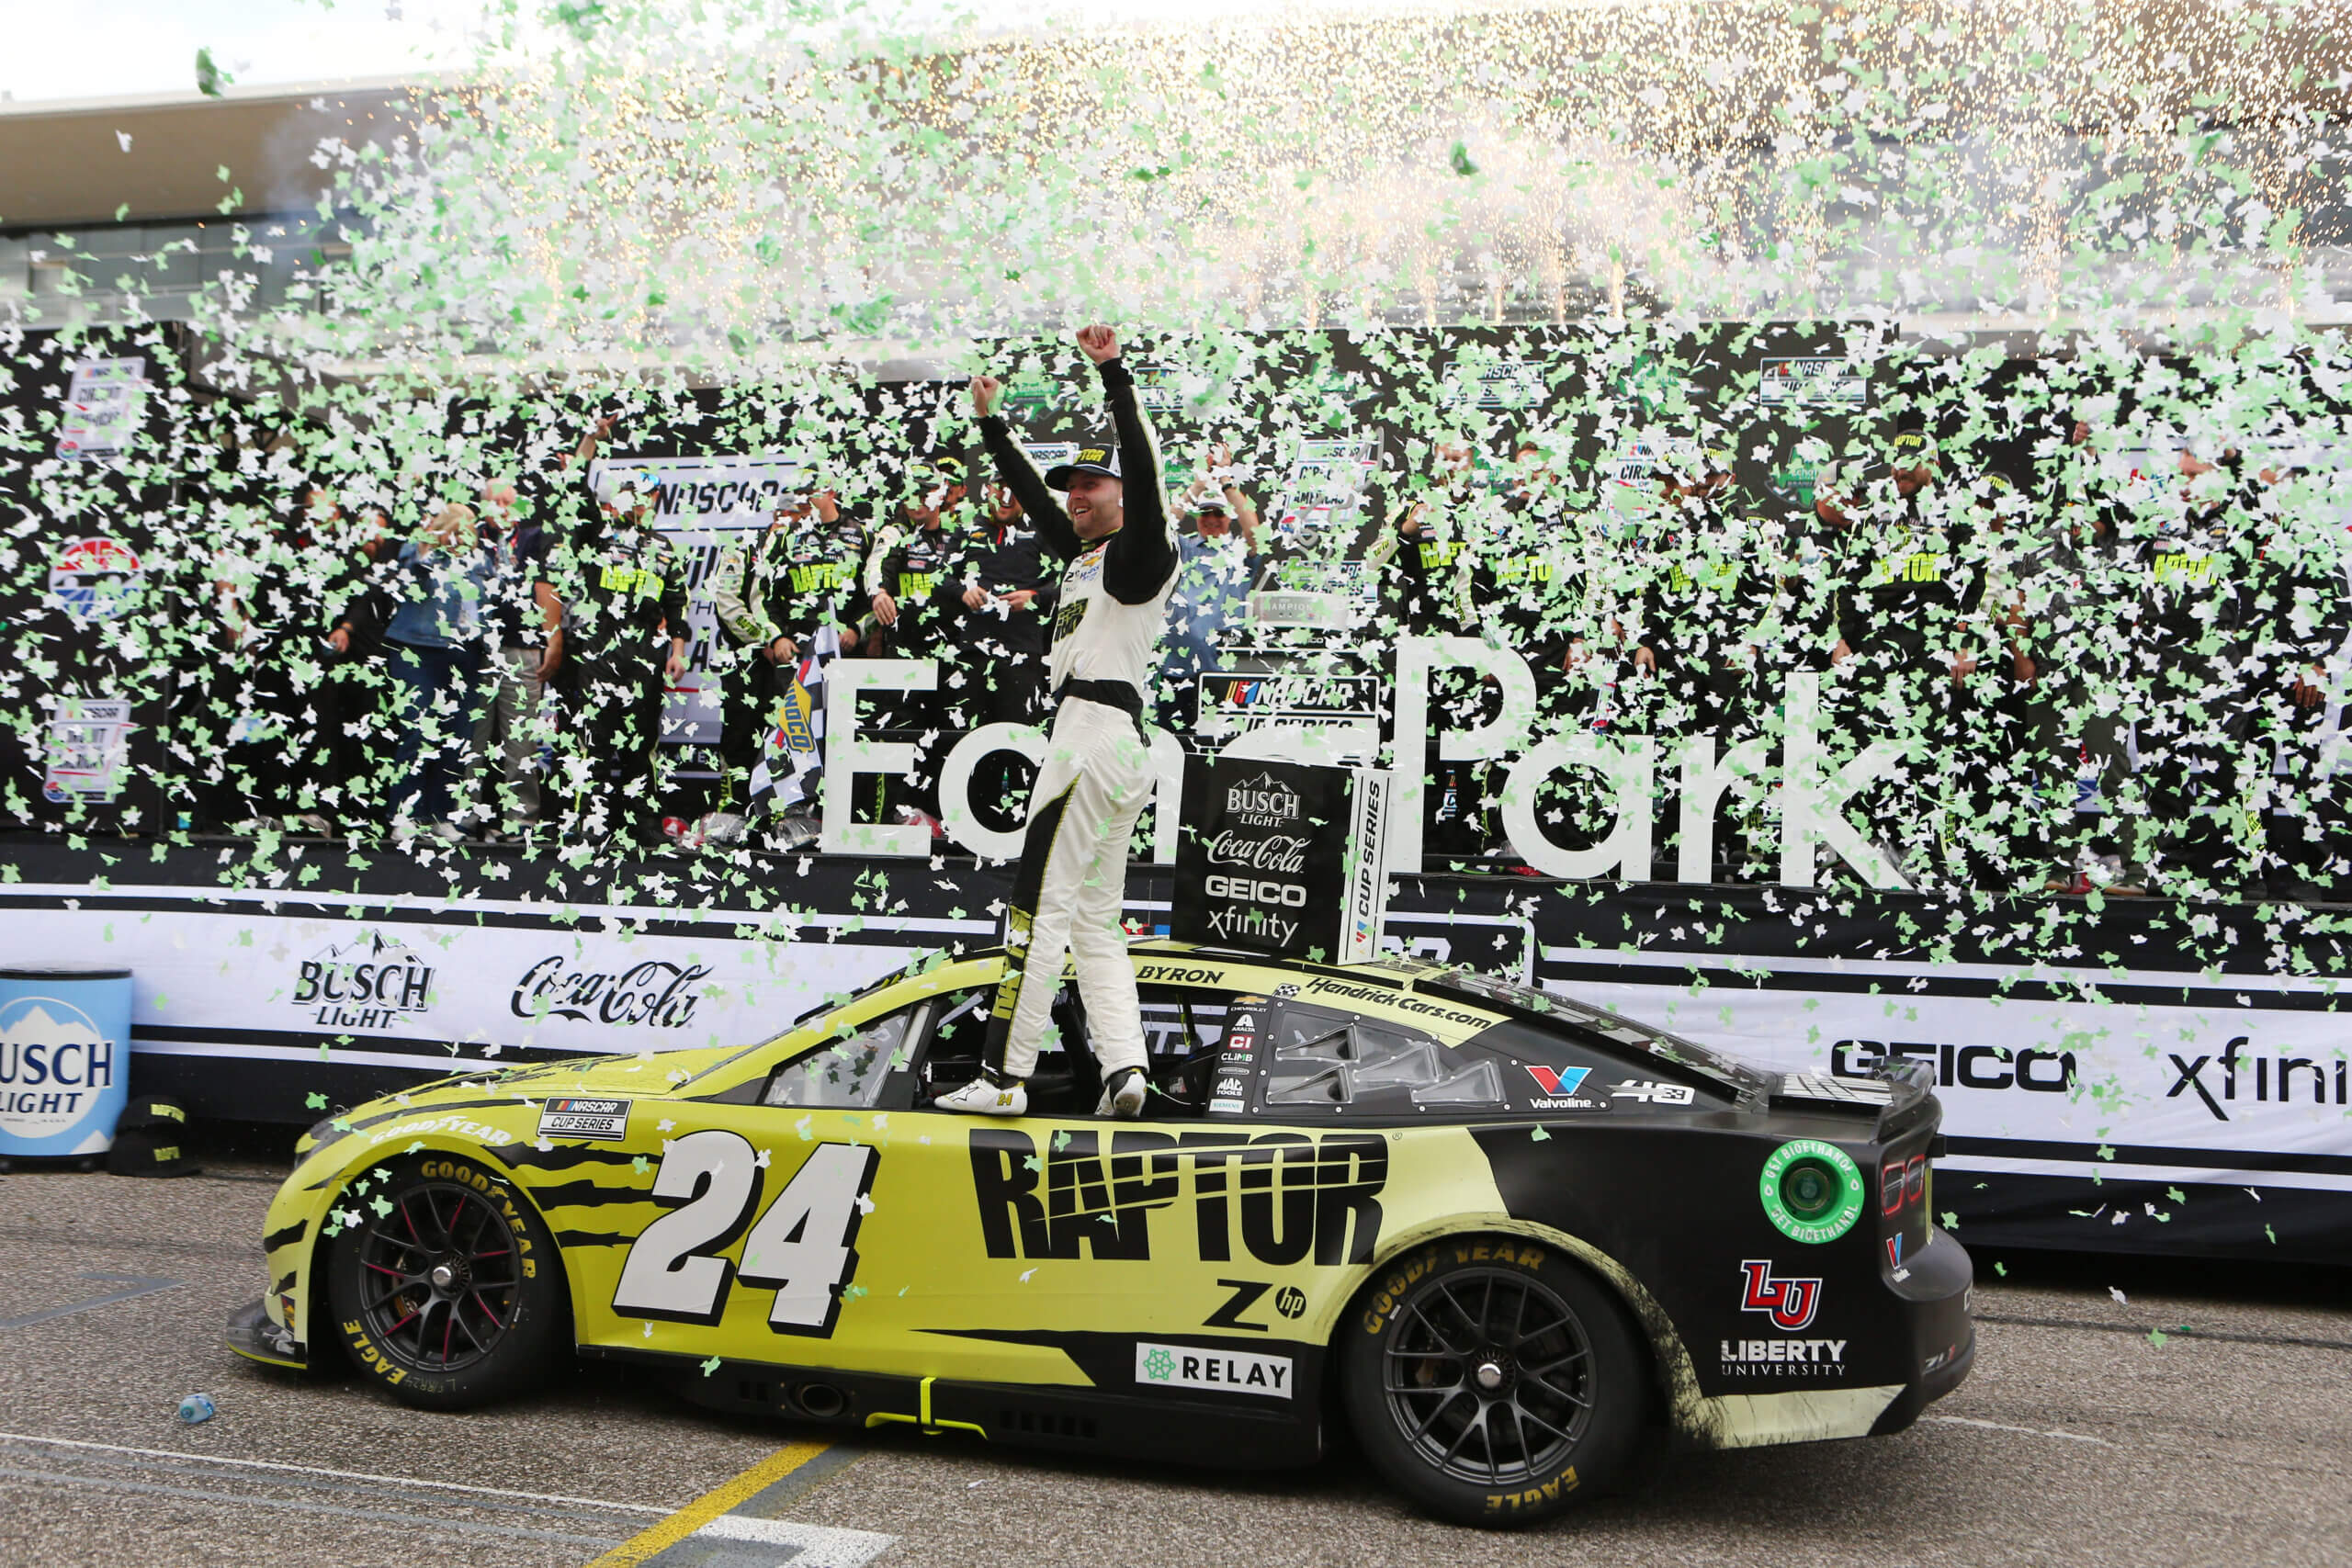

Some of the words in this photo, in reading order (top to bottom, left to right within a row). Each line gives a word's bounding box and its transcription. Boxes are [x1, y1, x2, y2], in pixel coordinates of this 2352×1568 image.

[1392, 636, 1911, 891] Park
[1226, 787, 1301, 819] BUSCH
[1240, 815, 1284, 828] LIGHT
[1363, 780, 1380, 866] SERIES
[1206, 829, 1312, 874] Coca-Cola
[1205, 875, 1307, 908] GEICO
[1358, 872, 1373, 918] CUP
[1207, 906, 1299, 948] xfinity
[291, 961, 436, 1011] BUSCH
[1137, 965, 1226, 985] BYRON
[314, 1007, 395, 1029] LIGHT
[1831, 1039, 2076, 1093] GEICO
[571, 1100, 618, 1113] NASCAR
[1529, 1098, 1593, 1110] Valvoline
[551, 1116, 574, 1128] CUP
[574, 1118, 615, 1130] SERIES
[1765, 1155, 1783, 1179] GET
[969, 1129, 1389, 1266] RAPTOR
[611, 1129, 881, 1339] 24
[343, 1319, 408, 1385] EAGLE
[1721, 1339, 1848, 1361] LIBERTY
[1182, 1356, 1287, 1389] RELAY
[1722, 1364, 1847, 1376] UNIVERSITY
[1485, 1466, 1580, 1514] EAGLE
